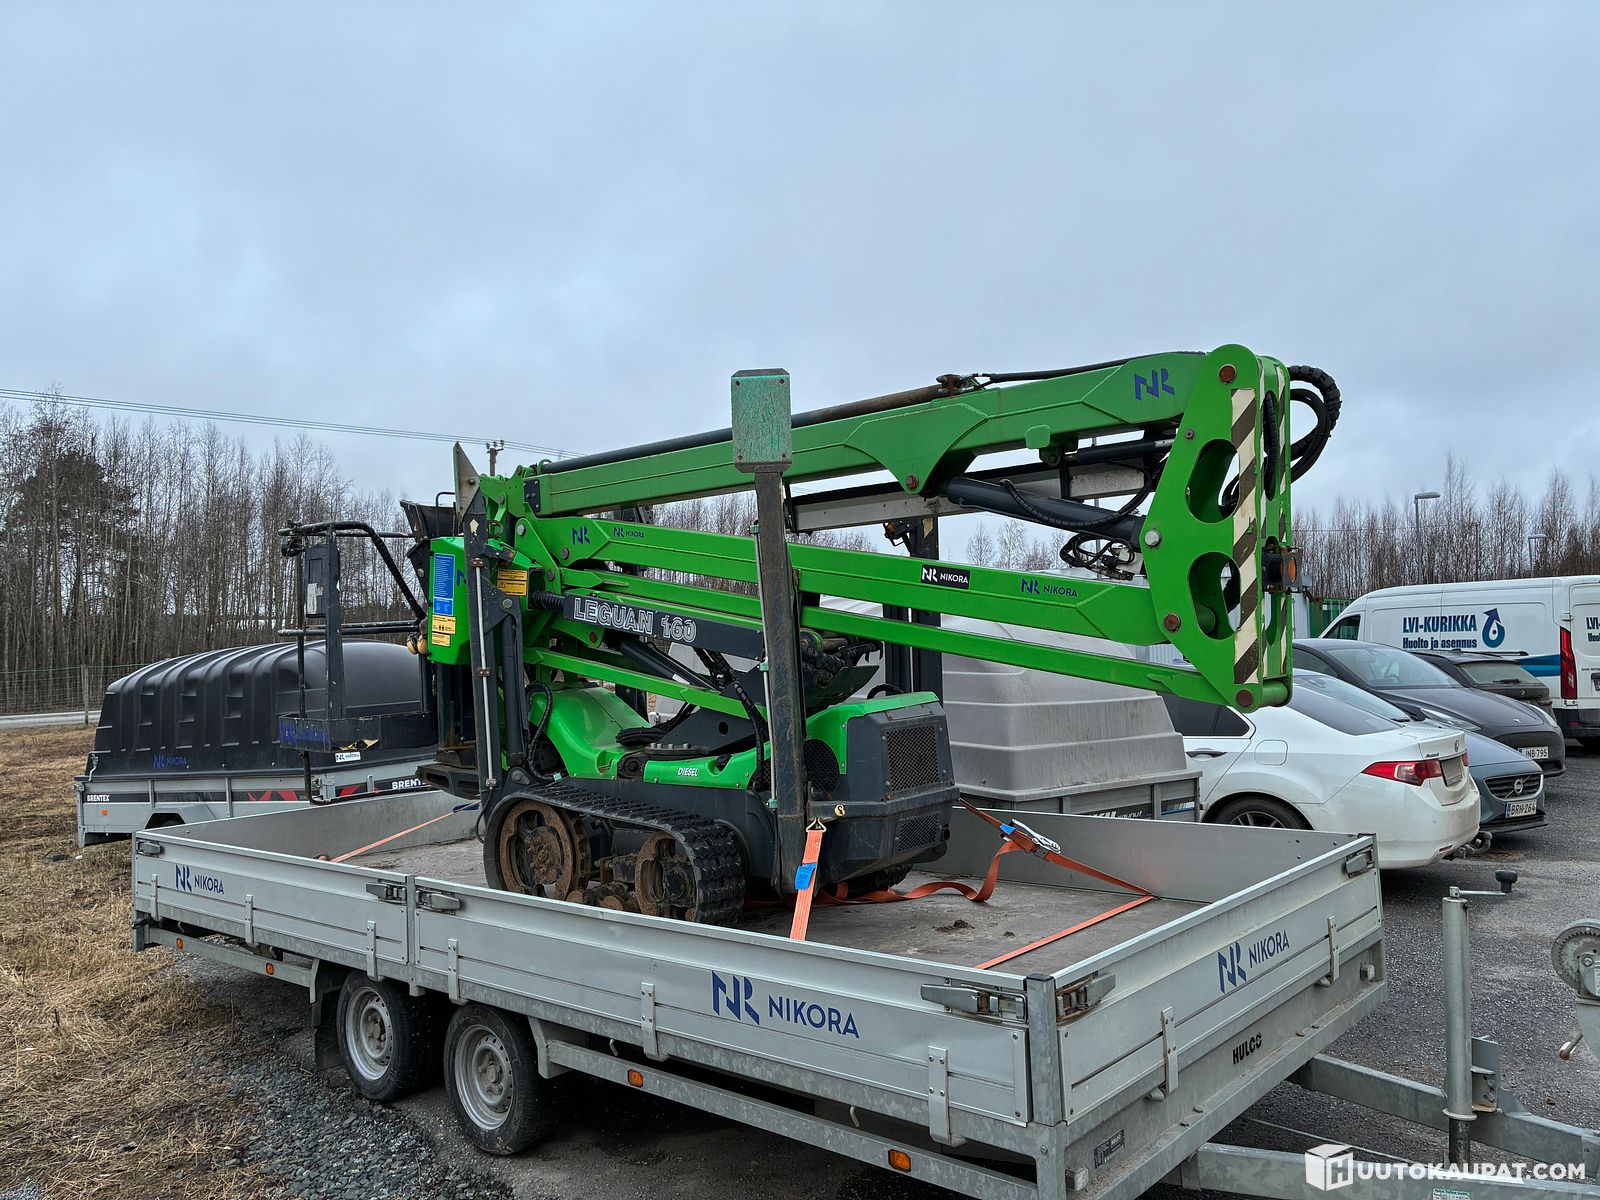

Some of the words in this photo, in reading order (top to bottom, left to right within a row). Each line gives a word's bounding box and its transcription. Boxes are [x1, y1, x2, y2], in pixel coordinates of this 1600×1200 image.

[625, 530, 645, 539] NIKORA
[939, 573, 969, 584] NIKORA
[1043, 584, 1078, 598] NIKORA
[573, 597, 654, 635] LEGUAN
[660, 614, 697, 643] 160
[1402, 614, 1478, 634] LVI-KURIKKA
[1402, 637, 1429, 649] Huolto
[1430, 636, 1439, 651] ja
[1440, 638, 1478, 649] asennus
[677, 767, 699, 777] DIESEL
[86, 794, 110, 802] BRENTEX
[194, 874, 225, 895] NIKORA
[1248, 929, 1290, 969] NIKORA
[768, 994, 860, 1039] NIKORA
